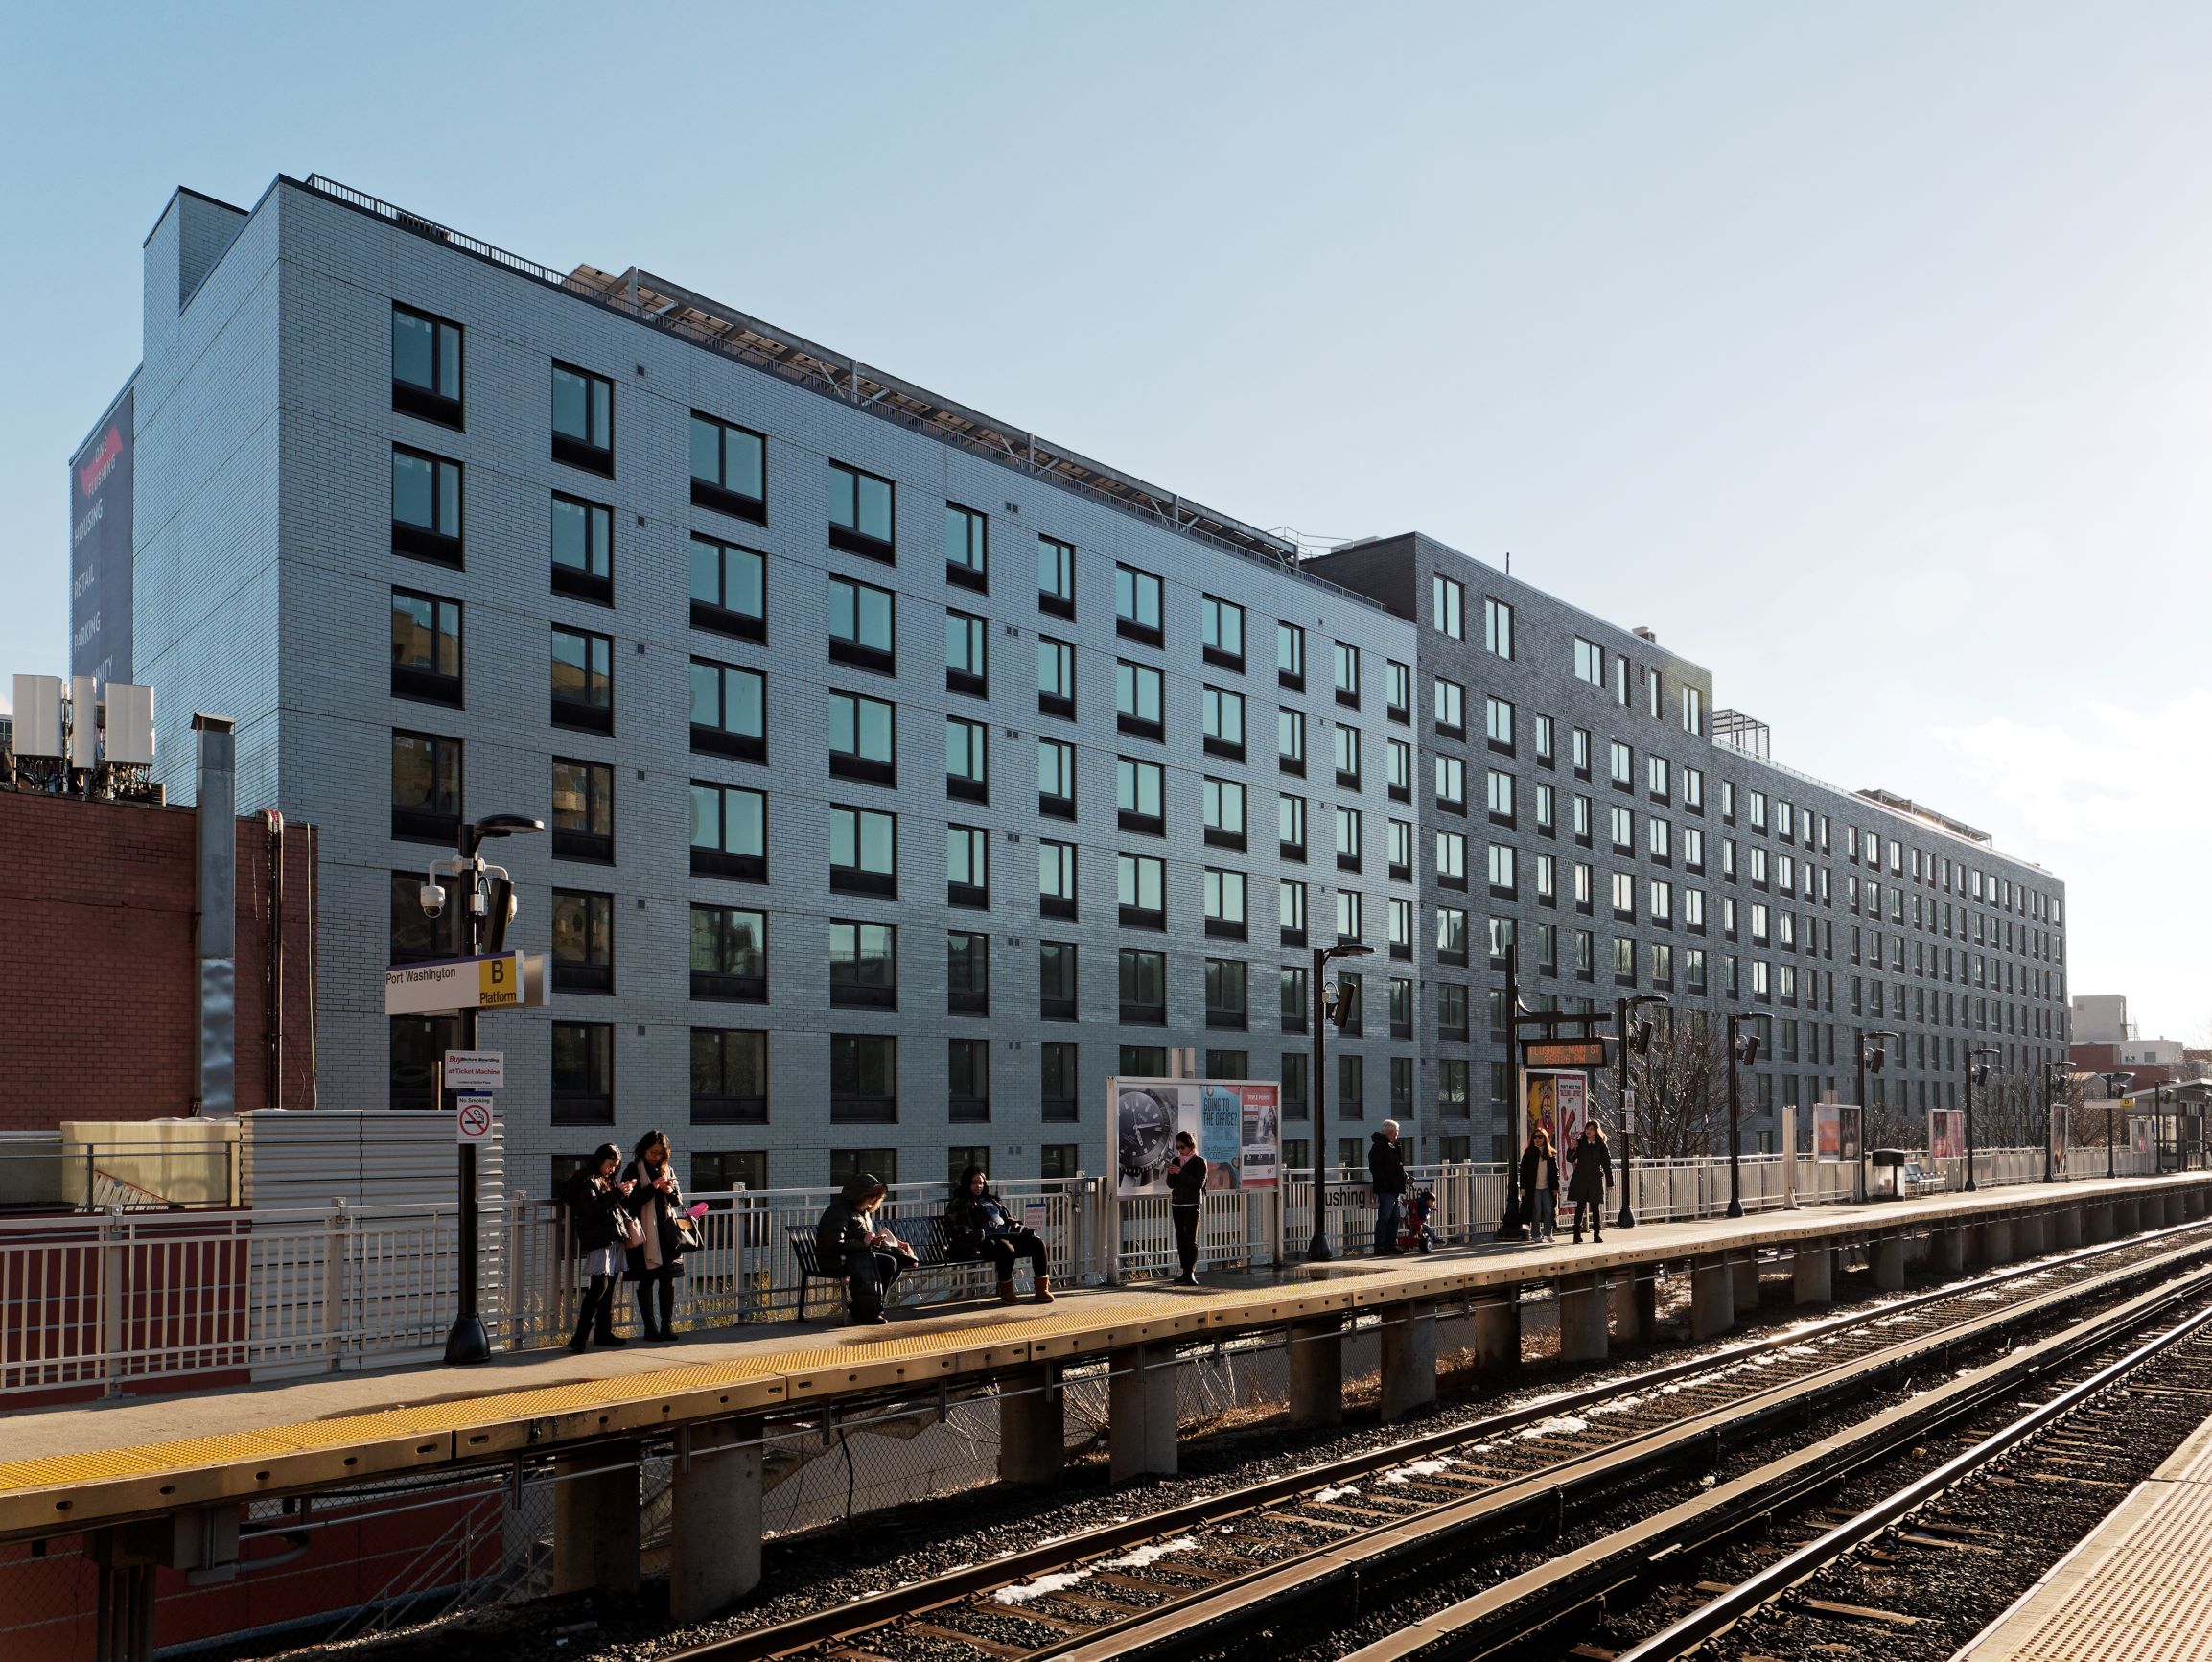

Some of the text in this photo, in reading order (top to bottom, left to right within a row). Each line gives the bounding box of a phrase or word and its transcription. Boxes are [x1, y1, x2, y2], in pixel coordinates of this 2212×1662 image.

[96, 436, 107, 463] ONE
[88, 453, 115, 499] FLUSHING
[74, 498, 103, 548] HOUSING
[74, 563, 95, 600] RETAIL
[74, 611, 101, 653] PARKING
[385, 967, 455, 985] Port Washington
[491, 960, 504, 984] B
[479, 991, 517, 1004] Platform
[1203, 1097, 1230, 1112] GOING TO
[1203, 1112, 1214, 1126] THE
[1215, 1112, 1238, 1126] OFFICE?
[1325, 1186, 1365, 1210] ushing
